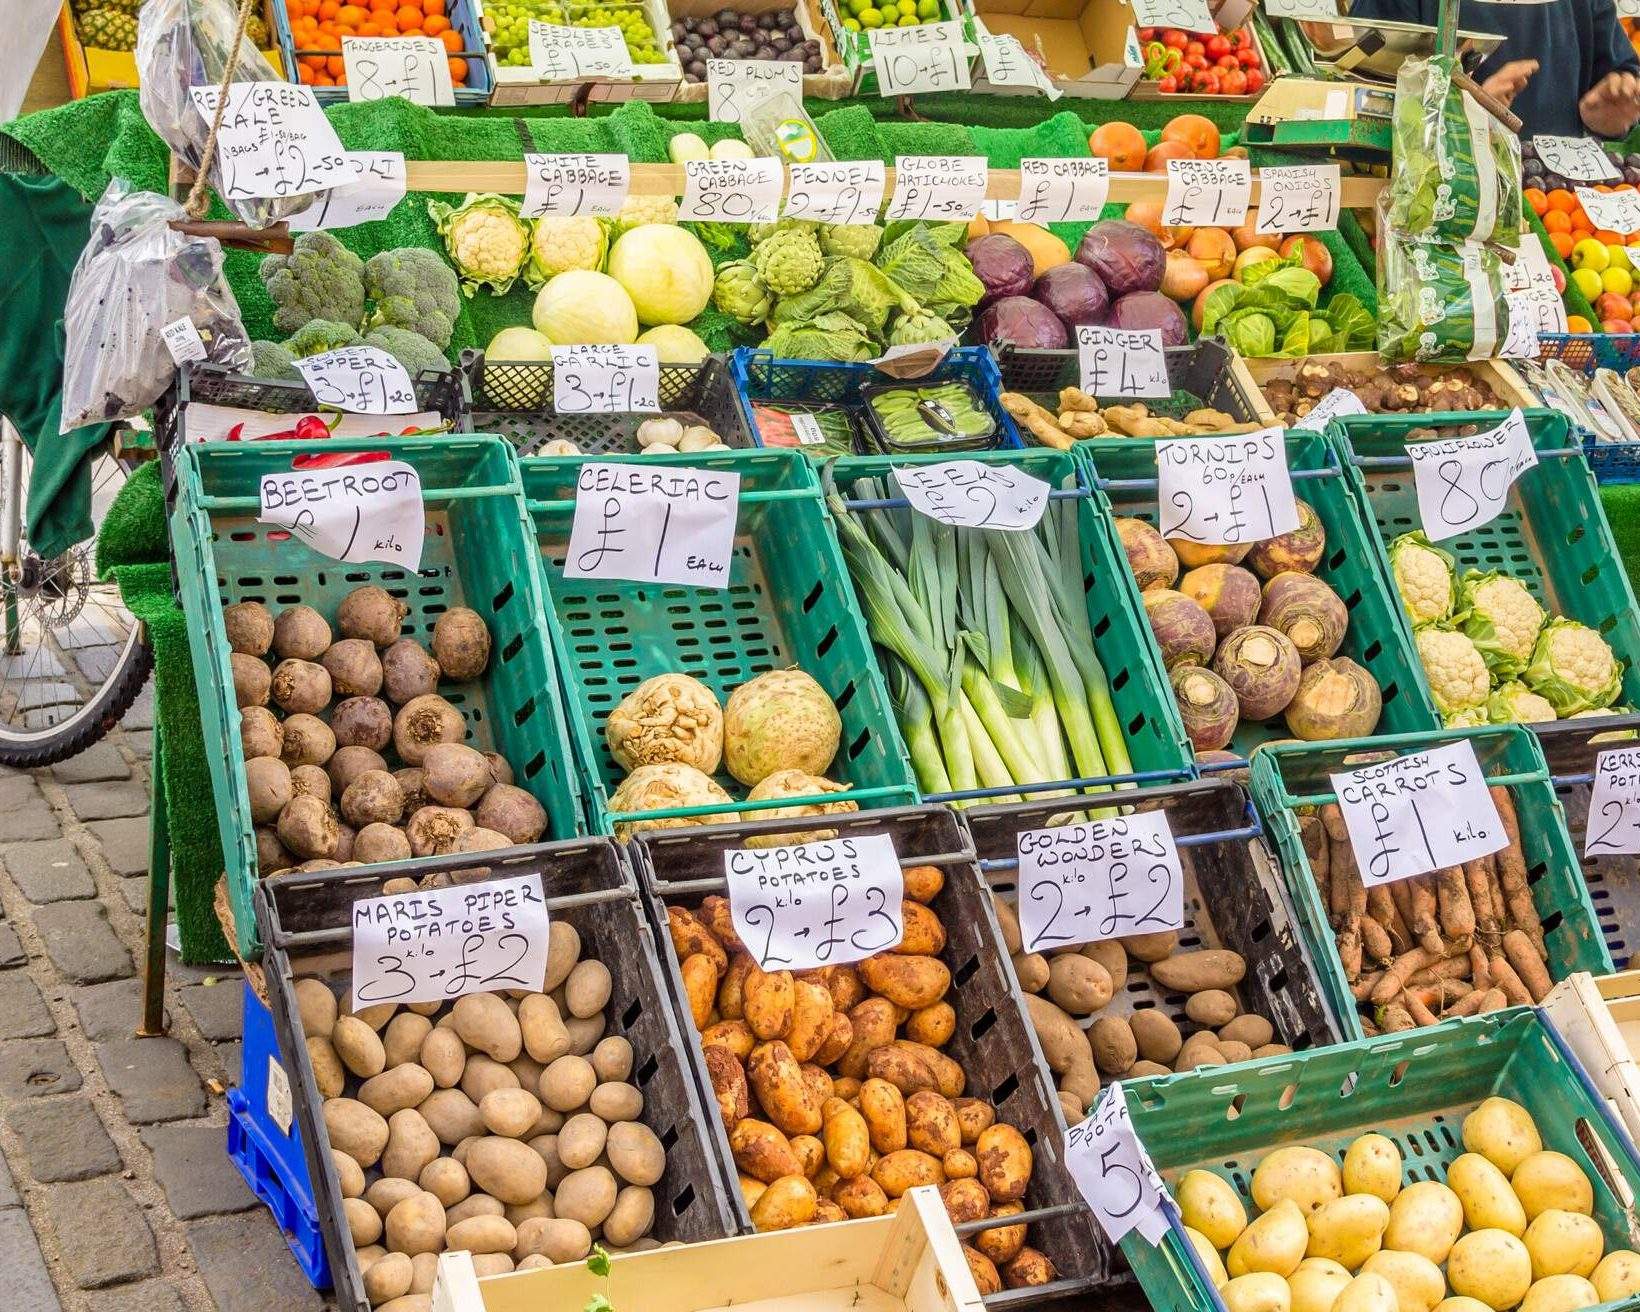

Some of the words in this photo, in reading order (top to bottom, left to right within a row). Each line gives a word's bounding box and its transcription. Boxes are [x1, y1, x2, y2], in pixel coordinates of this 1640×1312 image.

[343, 40, 438, 54] TANGERINES
[531, 21, 621, 40] SEEDLESS
[542, 38, 612, 50] GRAPES
[873, 27, 948, 46] LIMES
[356, 59, 385, 101] 8
[399, 54, 438, 105] £1
[707, 60, 736, 77] RED
[746, 64, 800, 84] PLUMS
[883, 54, 918, 90] 10
[930, 47, 959, 86] £1
[716, 82, 741, 123] 8
[528, 155, 601, 168] WHITE
[539, 168, 624, 187] CABBAGE
[686, 160, 748, 177] GREEN
[791, 166, 880, 185] FENNEL
[901, 157, 965, 172] GLOBE
[1023, 161, 1049, 176] RED
[1053, 160, 1108, 177] CABBAGE
[1170, 160, 1229, 173] SPRING
[1263, 168, 1317, 180] SPANISH
[698, 170, 773, 191] CABBAGE
[897, 172, 986, 188] ARTICHOKES
[1181, 172, 1247, 186] CABBAGE
[1273, 177, 1333, 193] ONIONS
[531, 184, 584, 218] £1
[1021, 180, 1076, 221] £1
[1169, 187, 1223, 226] £1
[1260, 196, 1285, 230] 2
[1300, 189, 1334, 227] £1
[570, 344, 625, 355] LARGE
[1079, 327, 1161, 353] GINGER
[554, 355, 651, 369] GARLIC
[1084, 348, 1146, 396] £4
[315, 376, 346, 403] 3
[557, 373, 593, 411] 3
[1158, 435, 1275, 466] TURNIPS
[1409, 421, 1520, 461] CAULIFLOWER
[262, 471, 416, 510] BEETROOT
[579, 468, 730, 501] CELERIAC
[924, 486, 1024, 528] £2
[1017, 496, 1040, 514] kilo
[1163, 490, 1207, 541] 2
[1223, 484, 1275, 543] £1
[373, 534, 403, 553] kilo
[577, 497, 672, 577] £1
[1342, 763, 1468, 805] CARROTS
[1352, 756, 1430, 784] SCOTTISH
[1019, 818, 1129, 855] GOLDEN
[1369, 799, 1437, 878] £1
[1452, 820, 1488, 844] kilo
[1586, 800, 1626, 852] 2
[731, 839, 858, 875] CYPRUS
[1036, 833, 1167, 868] WONDERS
[758, 864, 861, 890] POTATOES
[355, 899, 444, 929] MARIS
[464, 884, 542, 916] PIPER
[1030, 880, 1076, 949] 2
[1062, 867, 1086, 885] kilo
[1099, 862, 1181, 936] £2
[386, 912, 516, 946] POTATOES
[744, 904, 793, 967] 2
[775, 889, 802, 908] kilo
[815, 884, 899, 961] £3
[357, 955, 416, 1001] 3
[405, 943, 435, 958] kilo
[445, 933, 530, 994] £2
[1101, 1141, 1142, 1218] 5
